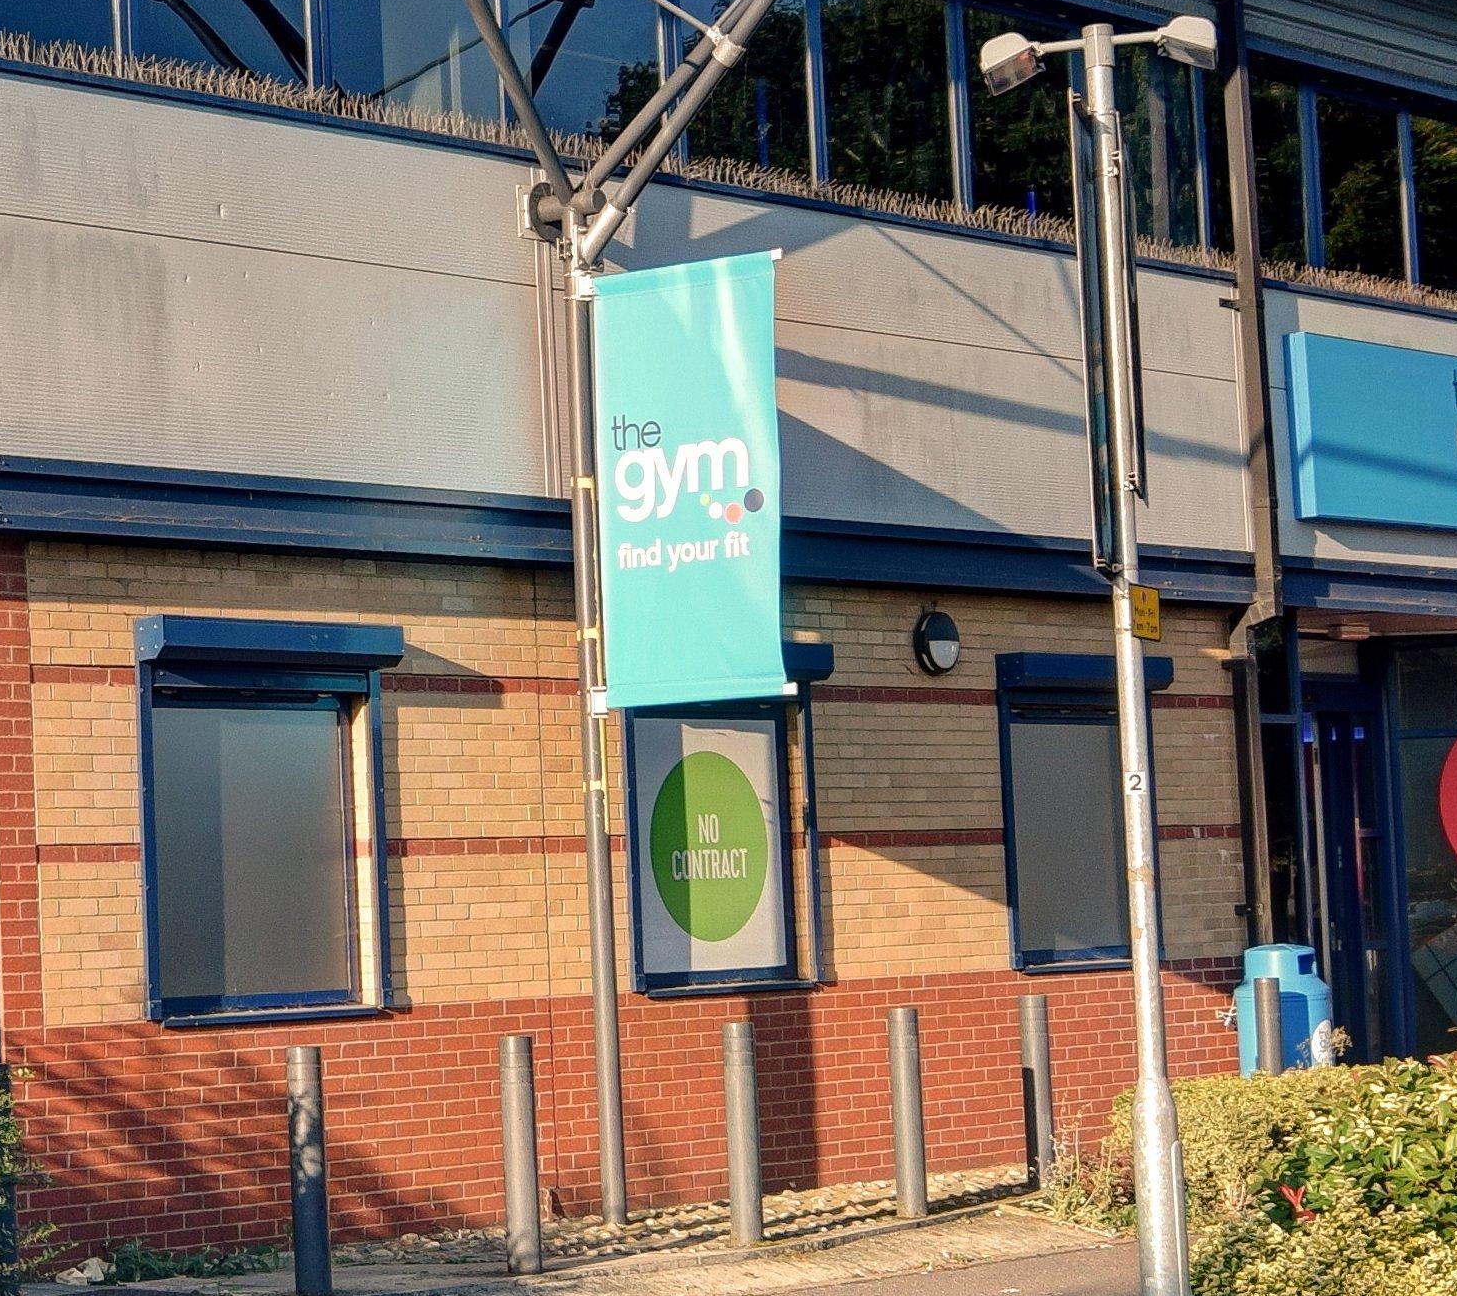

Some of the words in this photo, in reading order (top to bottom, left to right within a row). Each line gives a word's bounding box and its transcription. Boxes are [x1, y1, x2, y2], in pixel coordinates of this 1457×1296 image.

[611, 414, 661, 451] the
[614, 437, 750, 523] gym
[617, 538, 662, 570] find
[666, 539, 719, 573] your
[723, 530, 750, 559] fit
[1128, 773, 1143, 791] 2
[697, 812, 720, 844] NO
[671, 847, 749, 881] CONTRACT
